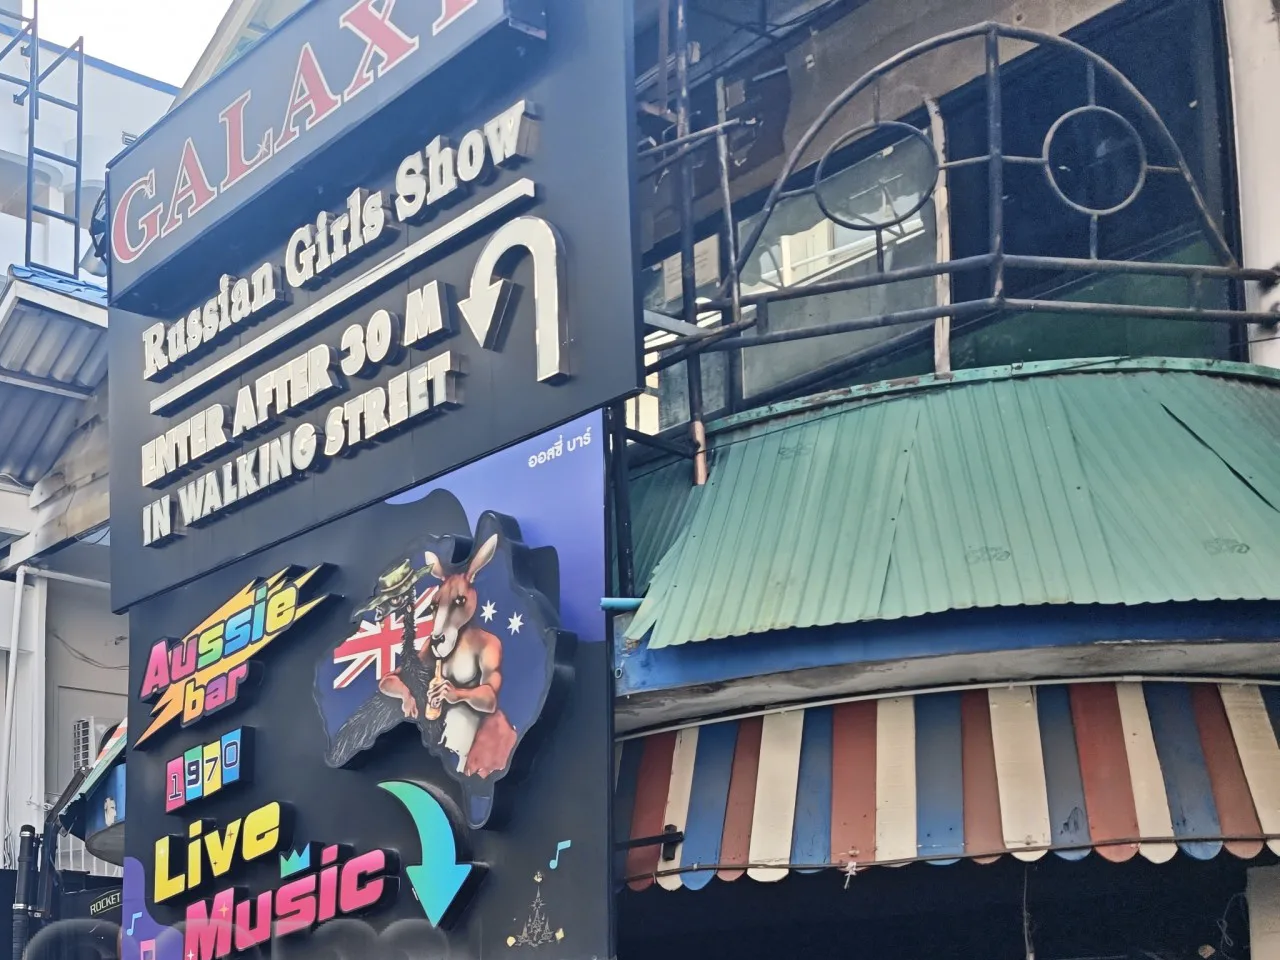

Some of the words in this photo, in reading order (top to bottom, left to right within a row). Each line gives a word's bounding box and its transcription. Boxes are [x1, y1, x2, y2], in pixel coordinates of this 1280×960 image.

[111, 0, 477, 264] GALAX
[143, 260, 276, 380] Russian
[284, 187, 385, 288] Girls
[394, 100, 527, 223] Show
[142, 404, 229, 488] ENTER
[232, 344, 336, 437] AFTER
[340, 309, 393, 378] 30
[403, 280, 446, 348] M
[142, 500, 172, 547] IN
[177, 423, 317, 529] WALKING
[323, 350, 452, 457] STREET
[566, 426, 592, 452] บาร์
[139, 584, 299, 700] Aussie
[181, 663, 249, 726] bar
[168, 740, 240, 801] 1970
[89, 892, 121, 916] ROCKET
[154, 801, 280, 904] Live
